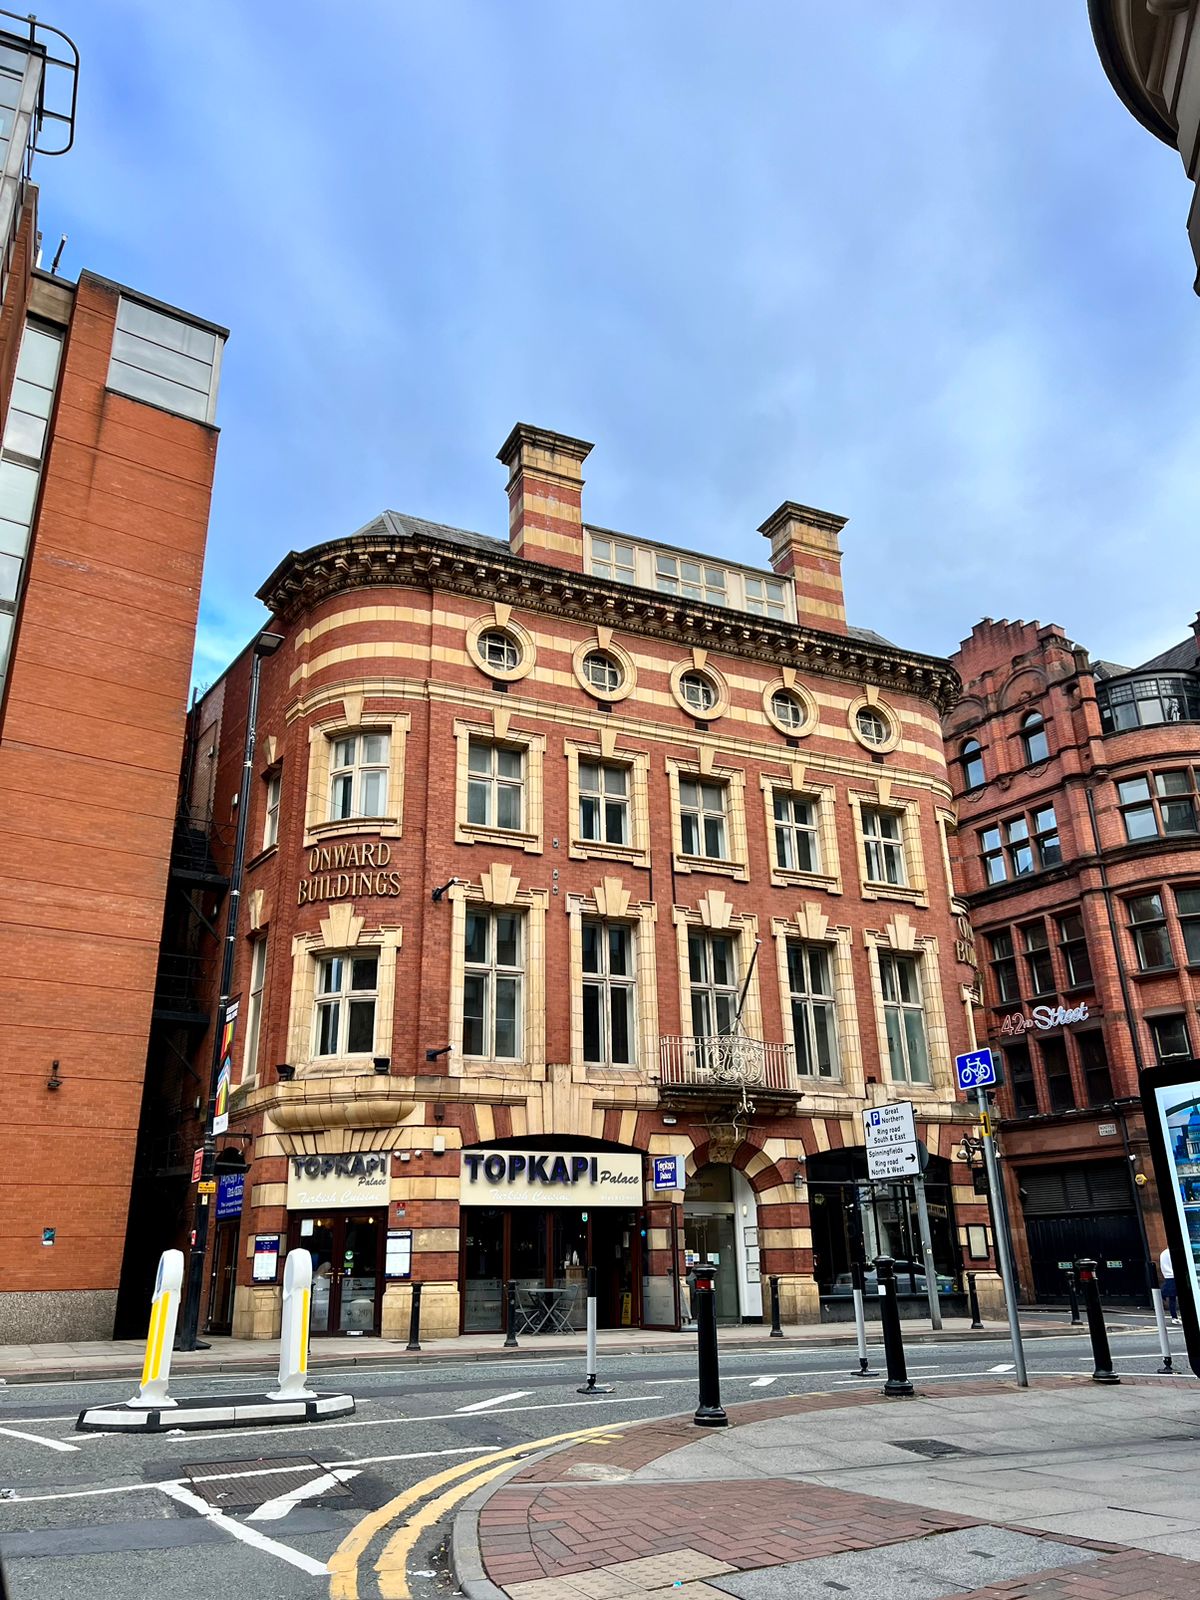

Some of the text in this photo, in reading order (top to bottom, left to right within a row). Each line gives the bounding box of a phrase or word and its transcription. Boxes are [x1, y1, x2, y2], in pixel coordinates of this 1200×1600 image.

[309, 842, 391, 873] ONWARD
[297, 871, 401, 905] BUILDINGS
[1032, 1001, 1090, 1030] Street
[885, 1107, 899, 1116] Great
[881, 1115, 904, 1124] Northern
[874, 1136, 889, 1144] South
[894, 1133, 906, 1141] East
[868, 1147, 904, 1158] Spinningfields
[291, 1152, 387, 1179] TOPKAPI
[464, 1154, 599, 1185] TOPKAPI
[600, 1170, 639, 1185] Palace
[871, 1168, 886, 1176] North
[358, 1176, 386, 1187] Palace
[297, 1191, 337, 1203] Turkish
[489, 1188, 529, 1201] Turkish
